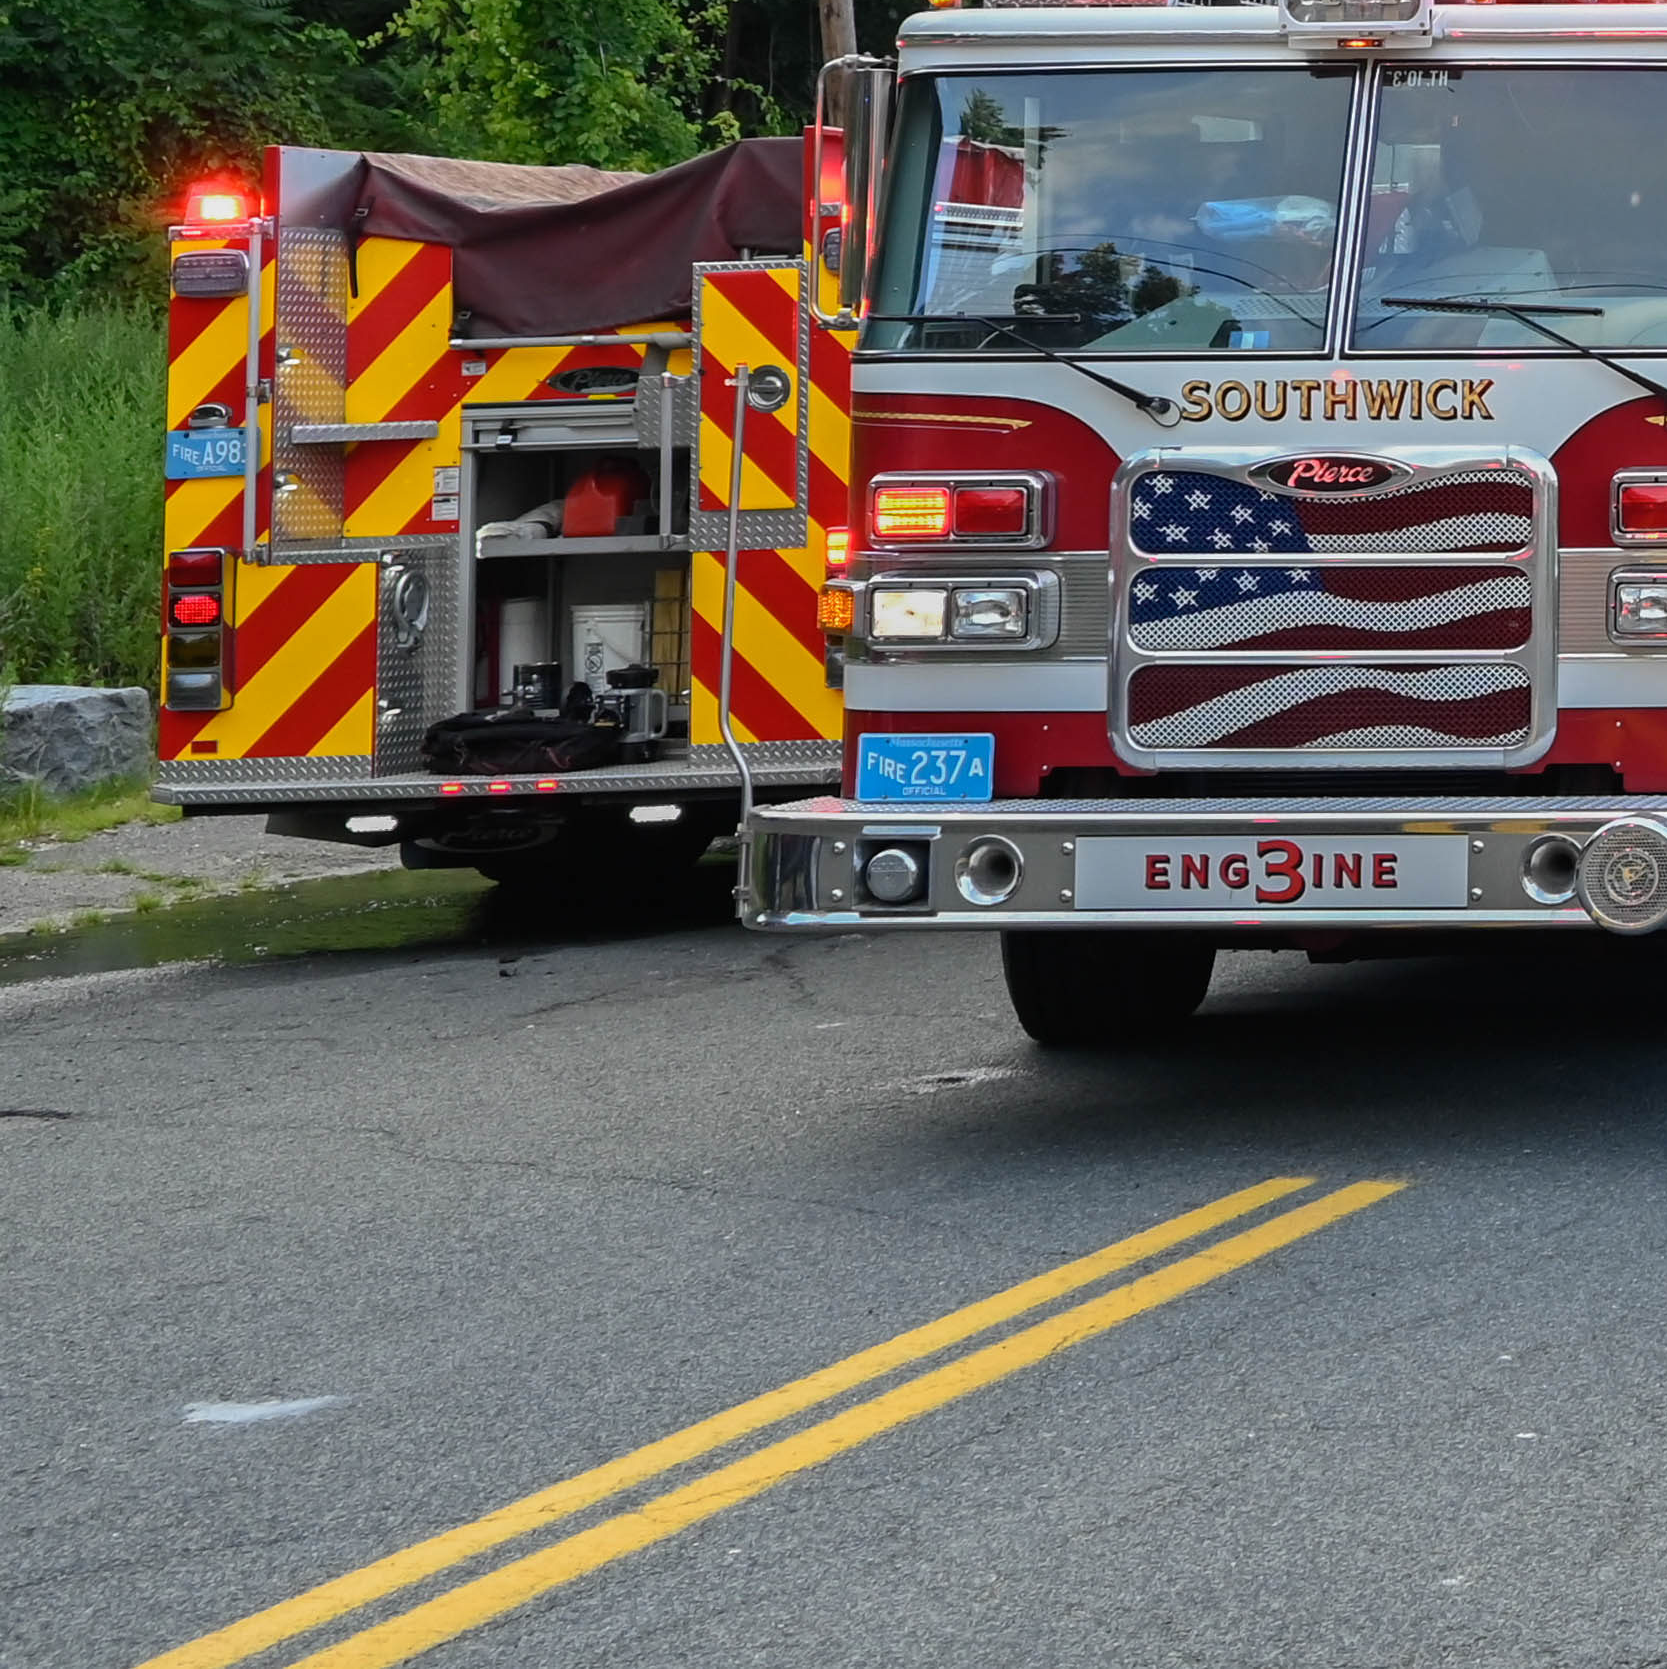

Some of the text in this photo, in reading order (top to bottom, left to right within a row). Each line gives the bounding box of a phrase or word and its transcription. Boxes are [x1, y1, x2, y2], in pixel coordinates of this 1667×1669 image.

[1181, 379, 1496, 421] SOUTHWICK
[172, 443, 200, 466] FIRE
[1288, 458, 1374, 487] Pierce
[867, 751, 907, 784] FIRE
[902, 786, 947, 796] OFFICIAL
